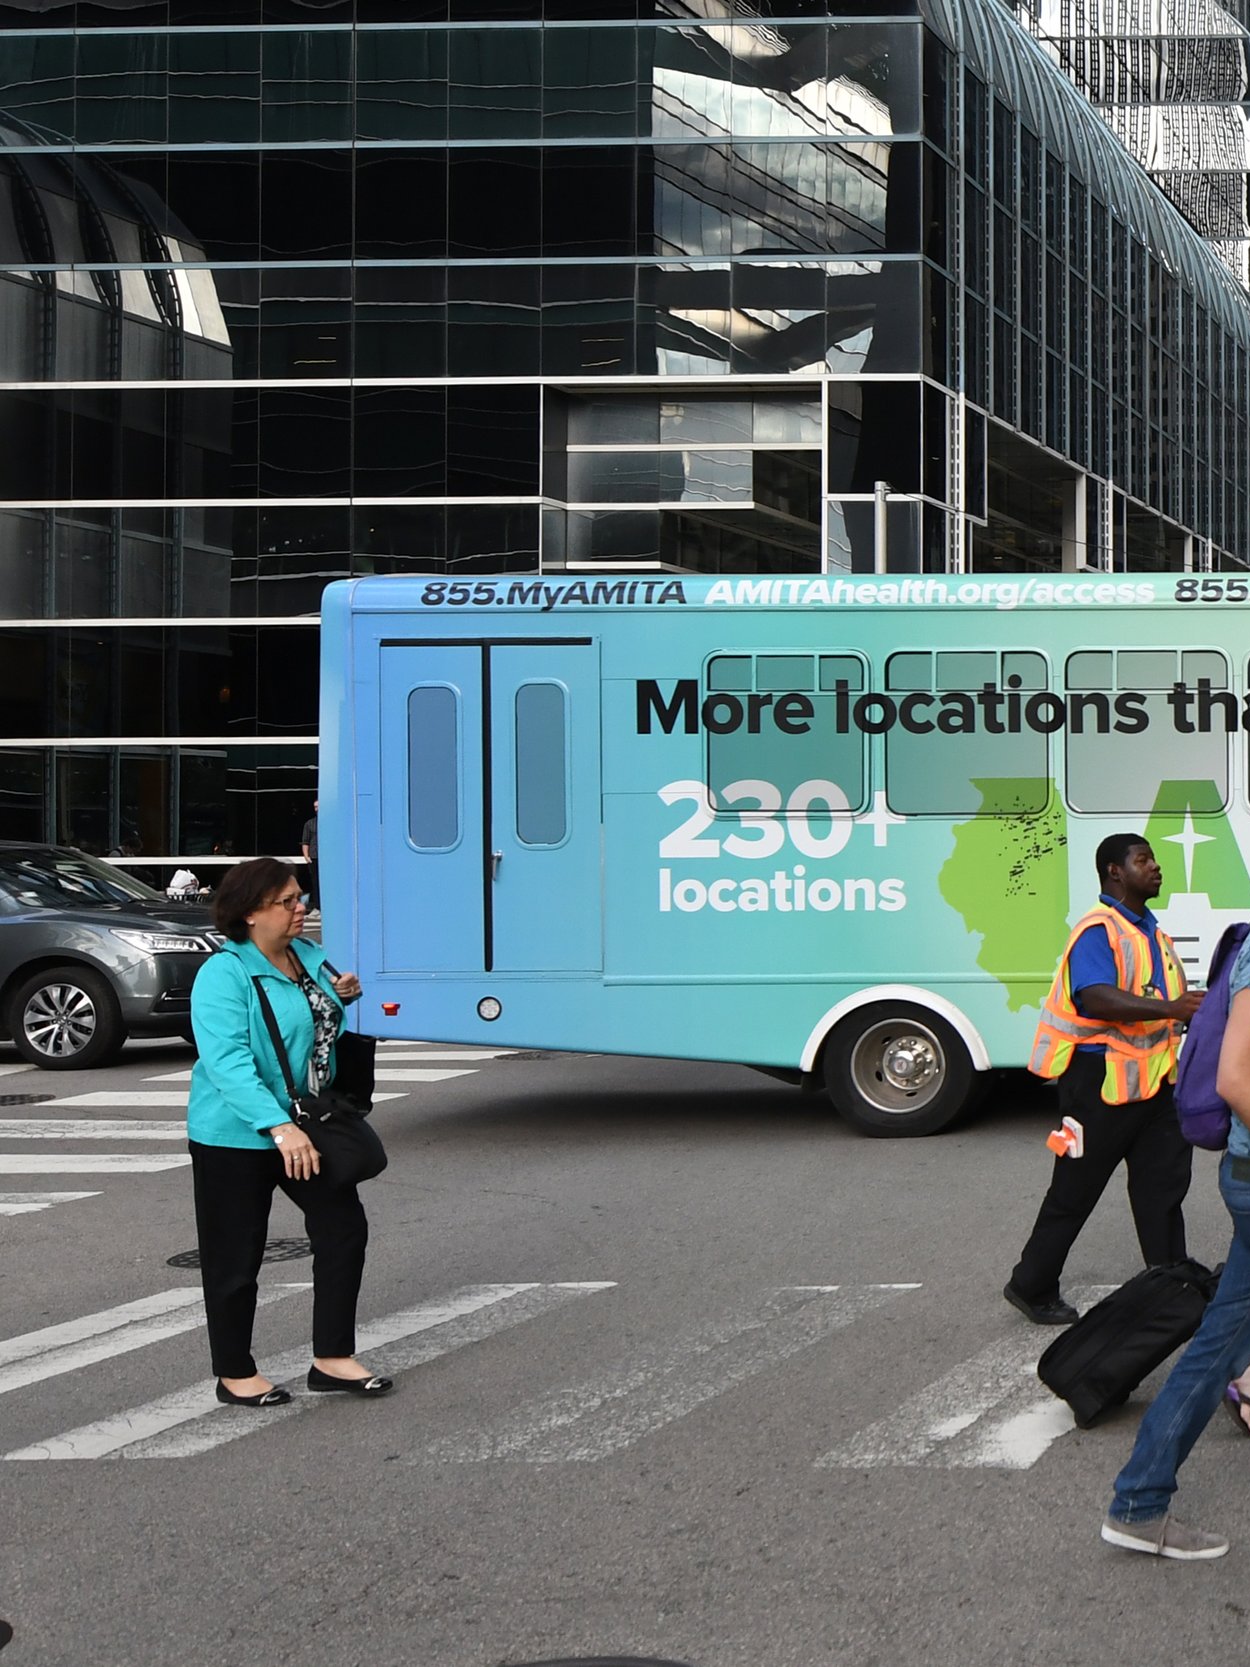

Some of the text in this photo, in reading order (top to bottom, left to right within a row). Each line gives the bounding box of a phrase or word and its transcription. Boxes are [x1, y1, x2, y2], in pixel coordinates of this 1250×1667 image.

[420, 580, 687, 611] 855.MyAMITA
[704, 578, 1155, 610] AMITAhealth.org/access
[636, 679, 815, 735] More
[835, 673, 1150, 734] locations
[657, 779, 907, 859] 230+
[659, 864, 907, 912] locations
